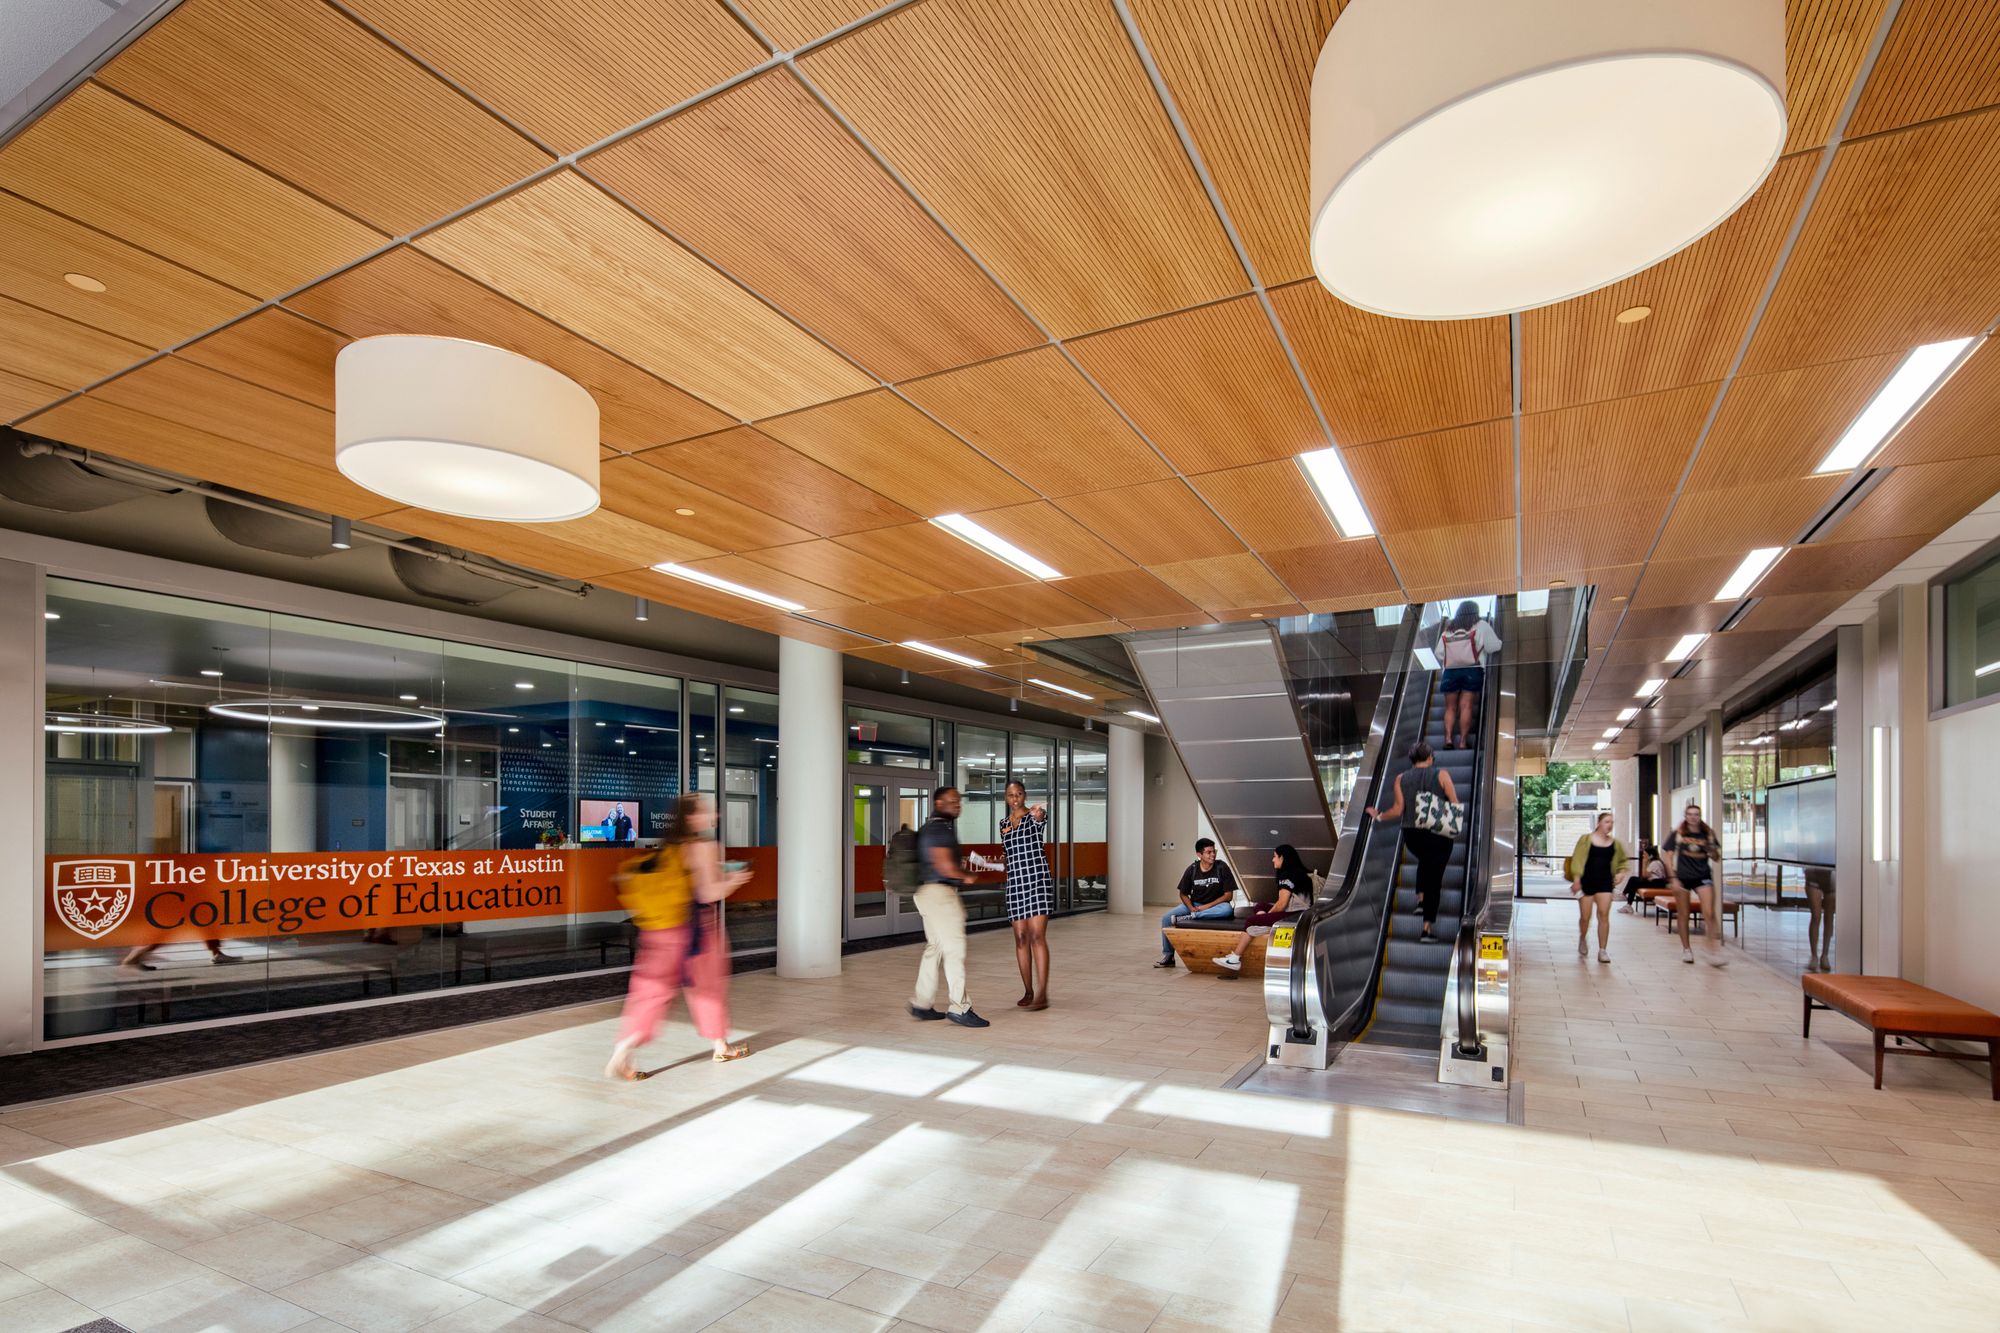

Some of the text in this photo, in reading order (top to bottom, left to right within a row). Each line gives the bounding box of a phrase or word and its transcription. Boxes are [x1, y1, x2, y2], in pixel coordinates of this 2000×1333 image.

[520, 808, 557, 818] STUDENT
[145, 854, 564, 885] The University of Texas at Austin
[144, 879, 563, 933] College of Education
